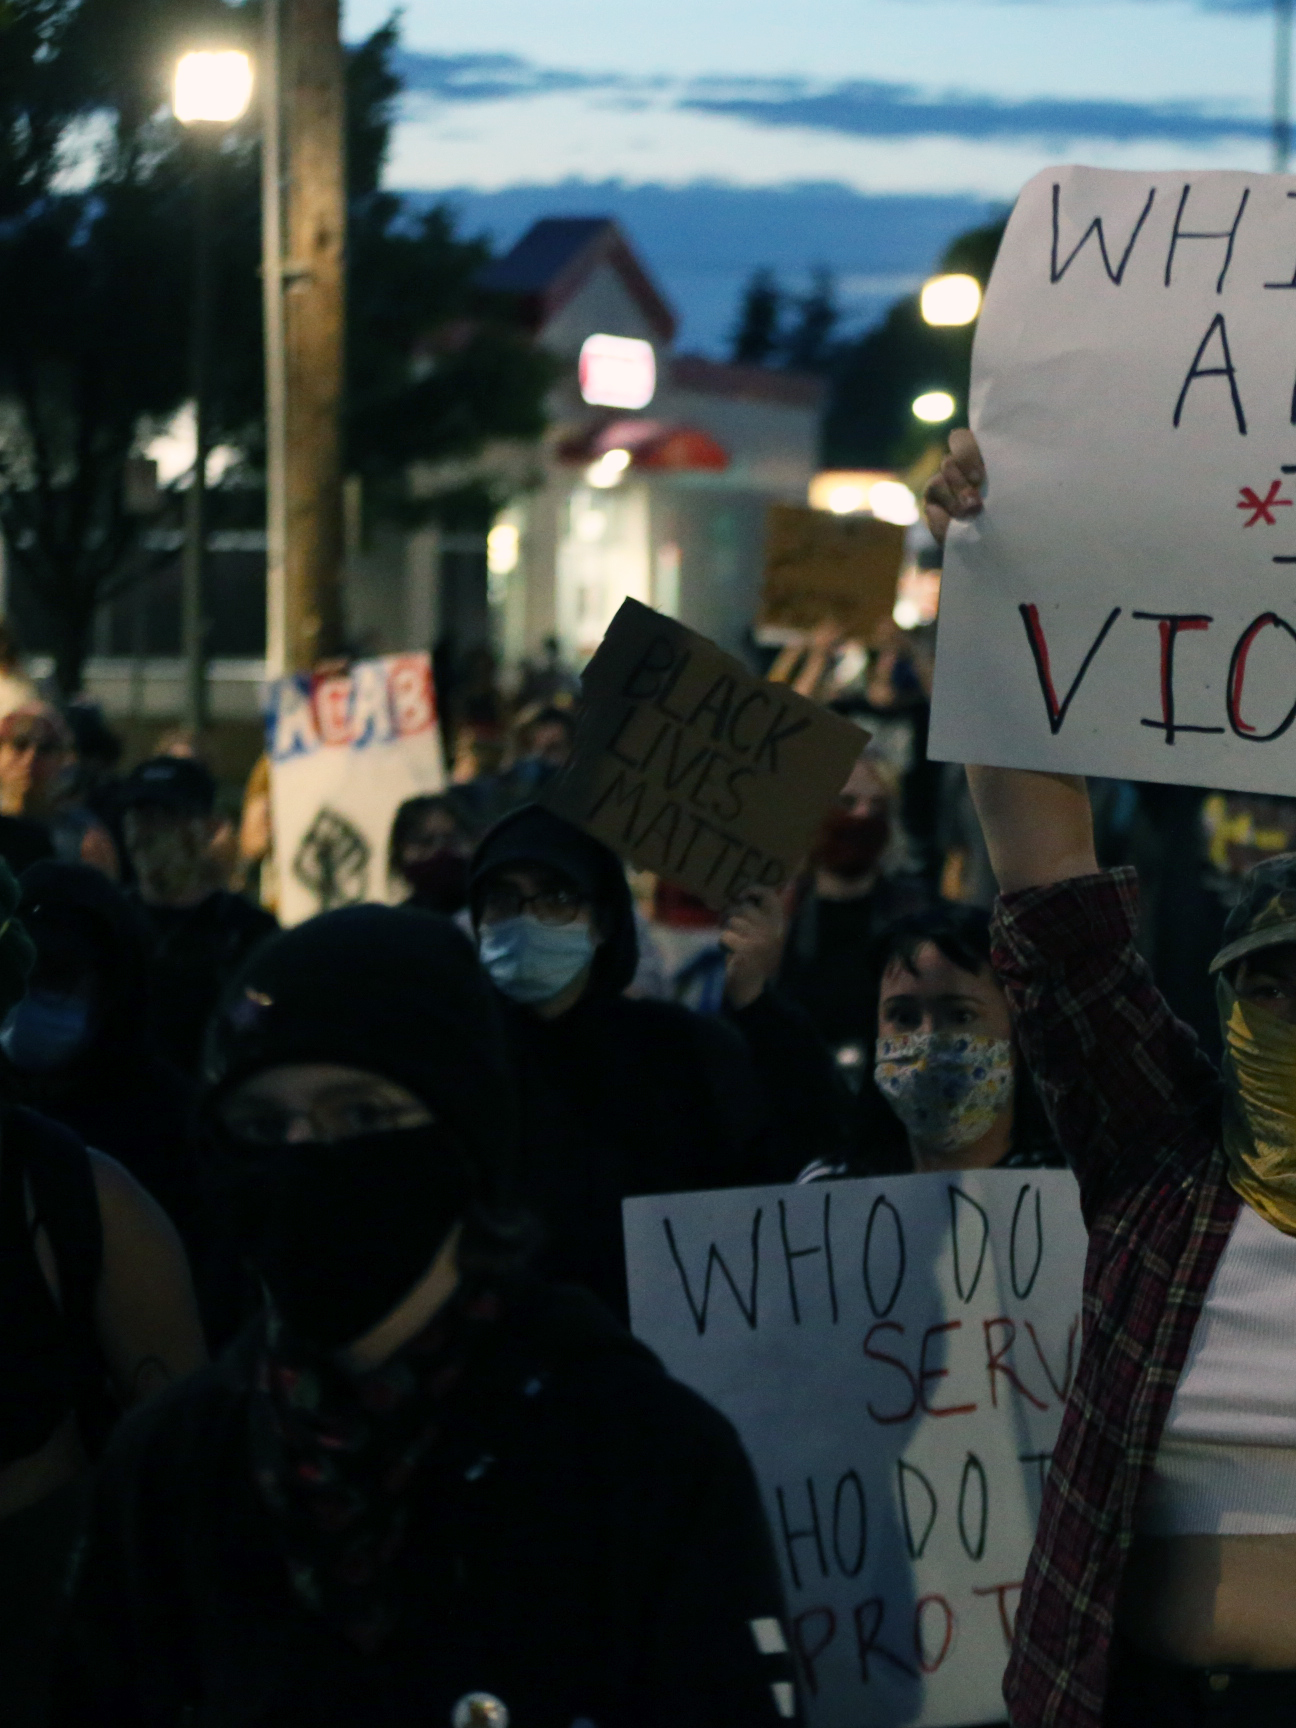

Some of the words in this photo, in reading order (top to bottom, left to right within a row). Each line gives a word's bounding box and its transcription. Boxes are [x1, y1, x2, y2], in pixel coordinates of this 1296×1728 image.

[604, 705, 757, 822] LIVES
[621, 635, 813, 774] BLACK
[664, 1190, 906, 1336] WHO
[948, 1183, 1043, 1304] DO
[898, 1450, 989, 1563] DO
